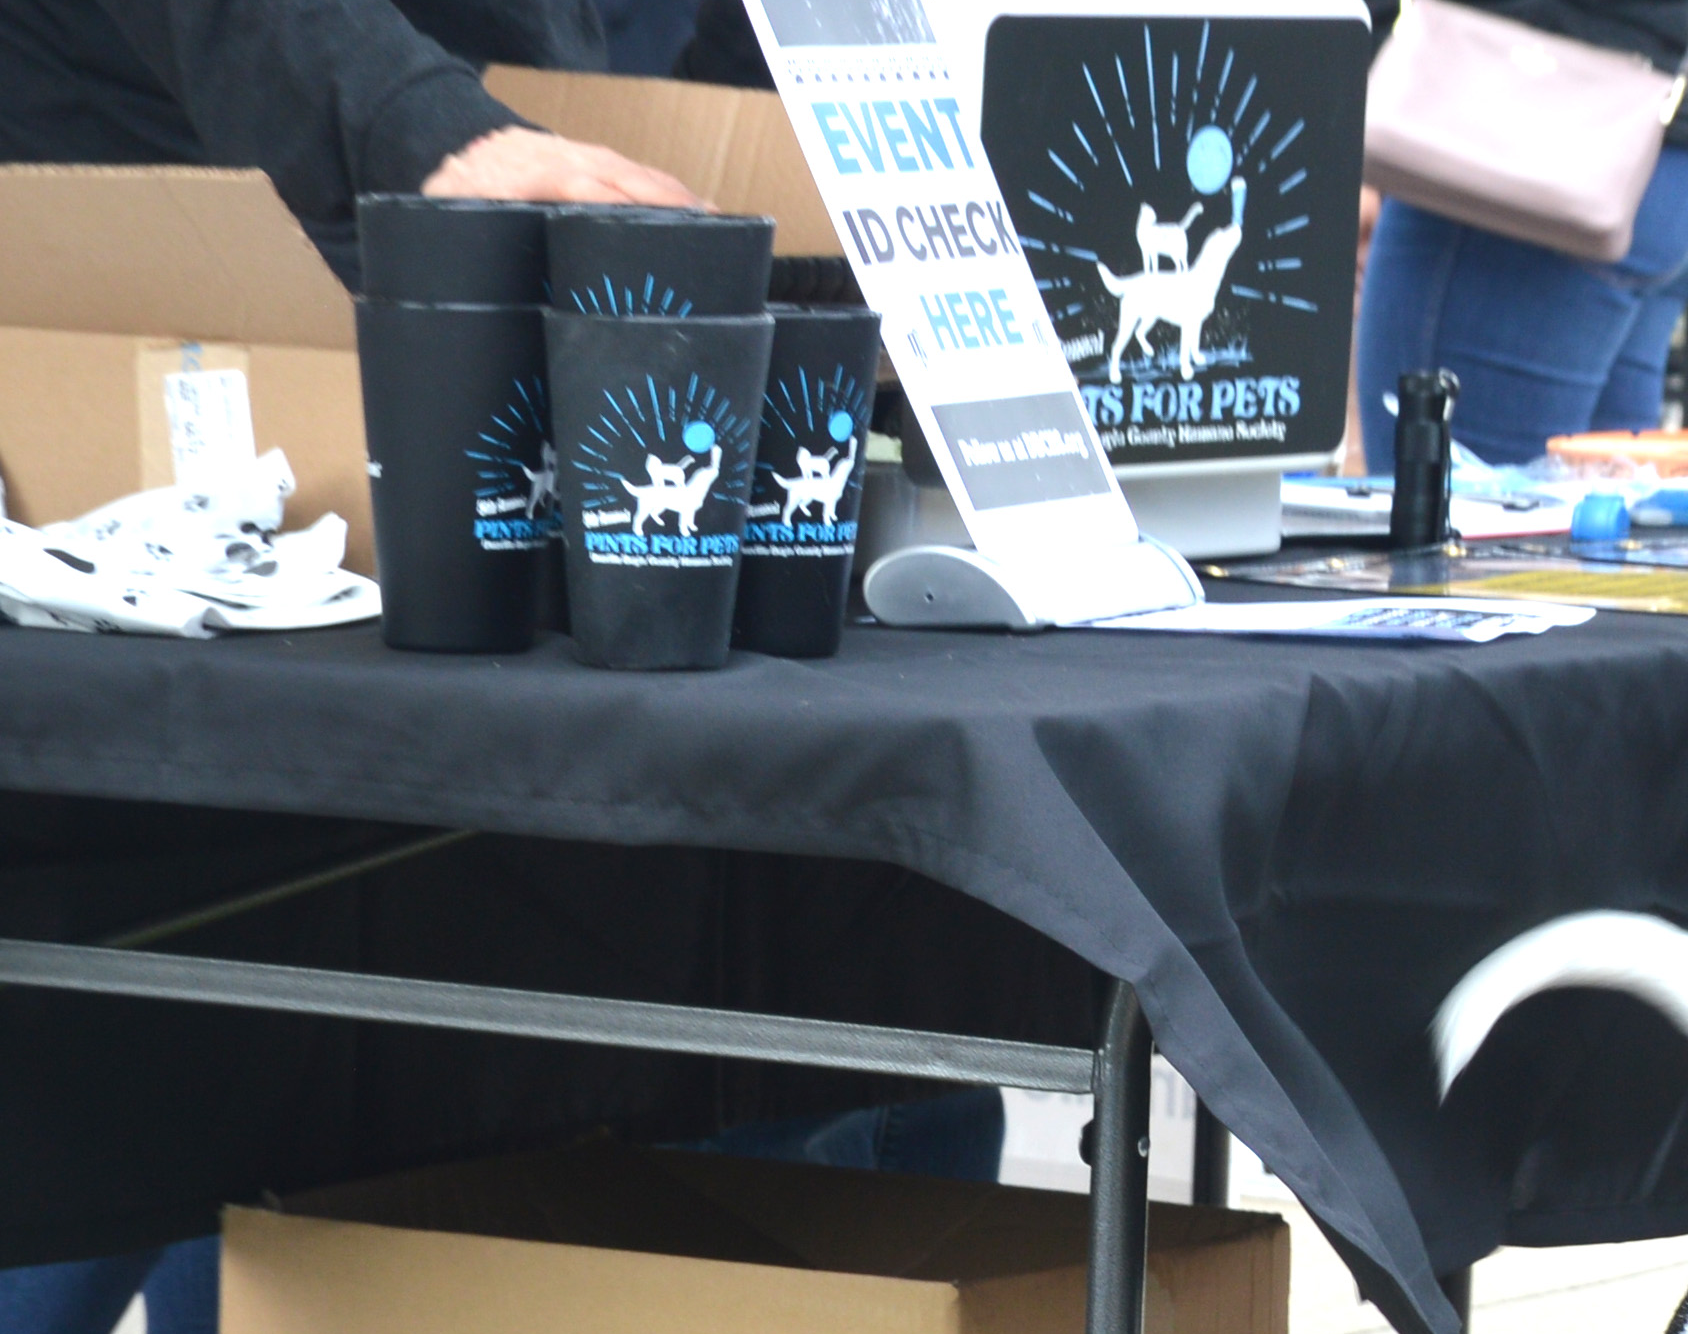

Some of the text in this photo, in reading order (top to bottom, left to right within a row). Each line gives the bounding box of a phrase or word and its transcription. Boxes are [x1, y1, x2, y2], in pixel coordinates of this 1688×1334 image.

[811, 98, 976, 176] EVENT
[842, 200, 1020, 267] ID CHECK
[919, 288, 1025, 352] HERE
[1130, 380, 1204, 425] FOR
[1209, 374, 1301, 421] PETS
[584, 531, 649, 555] PINTS
[650, 533, 699, 556] FOR
